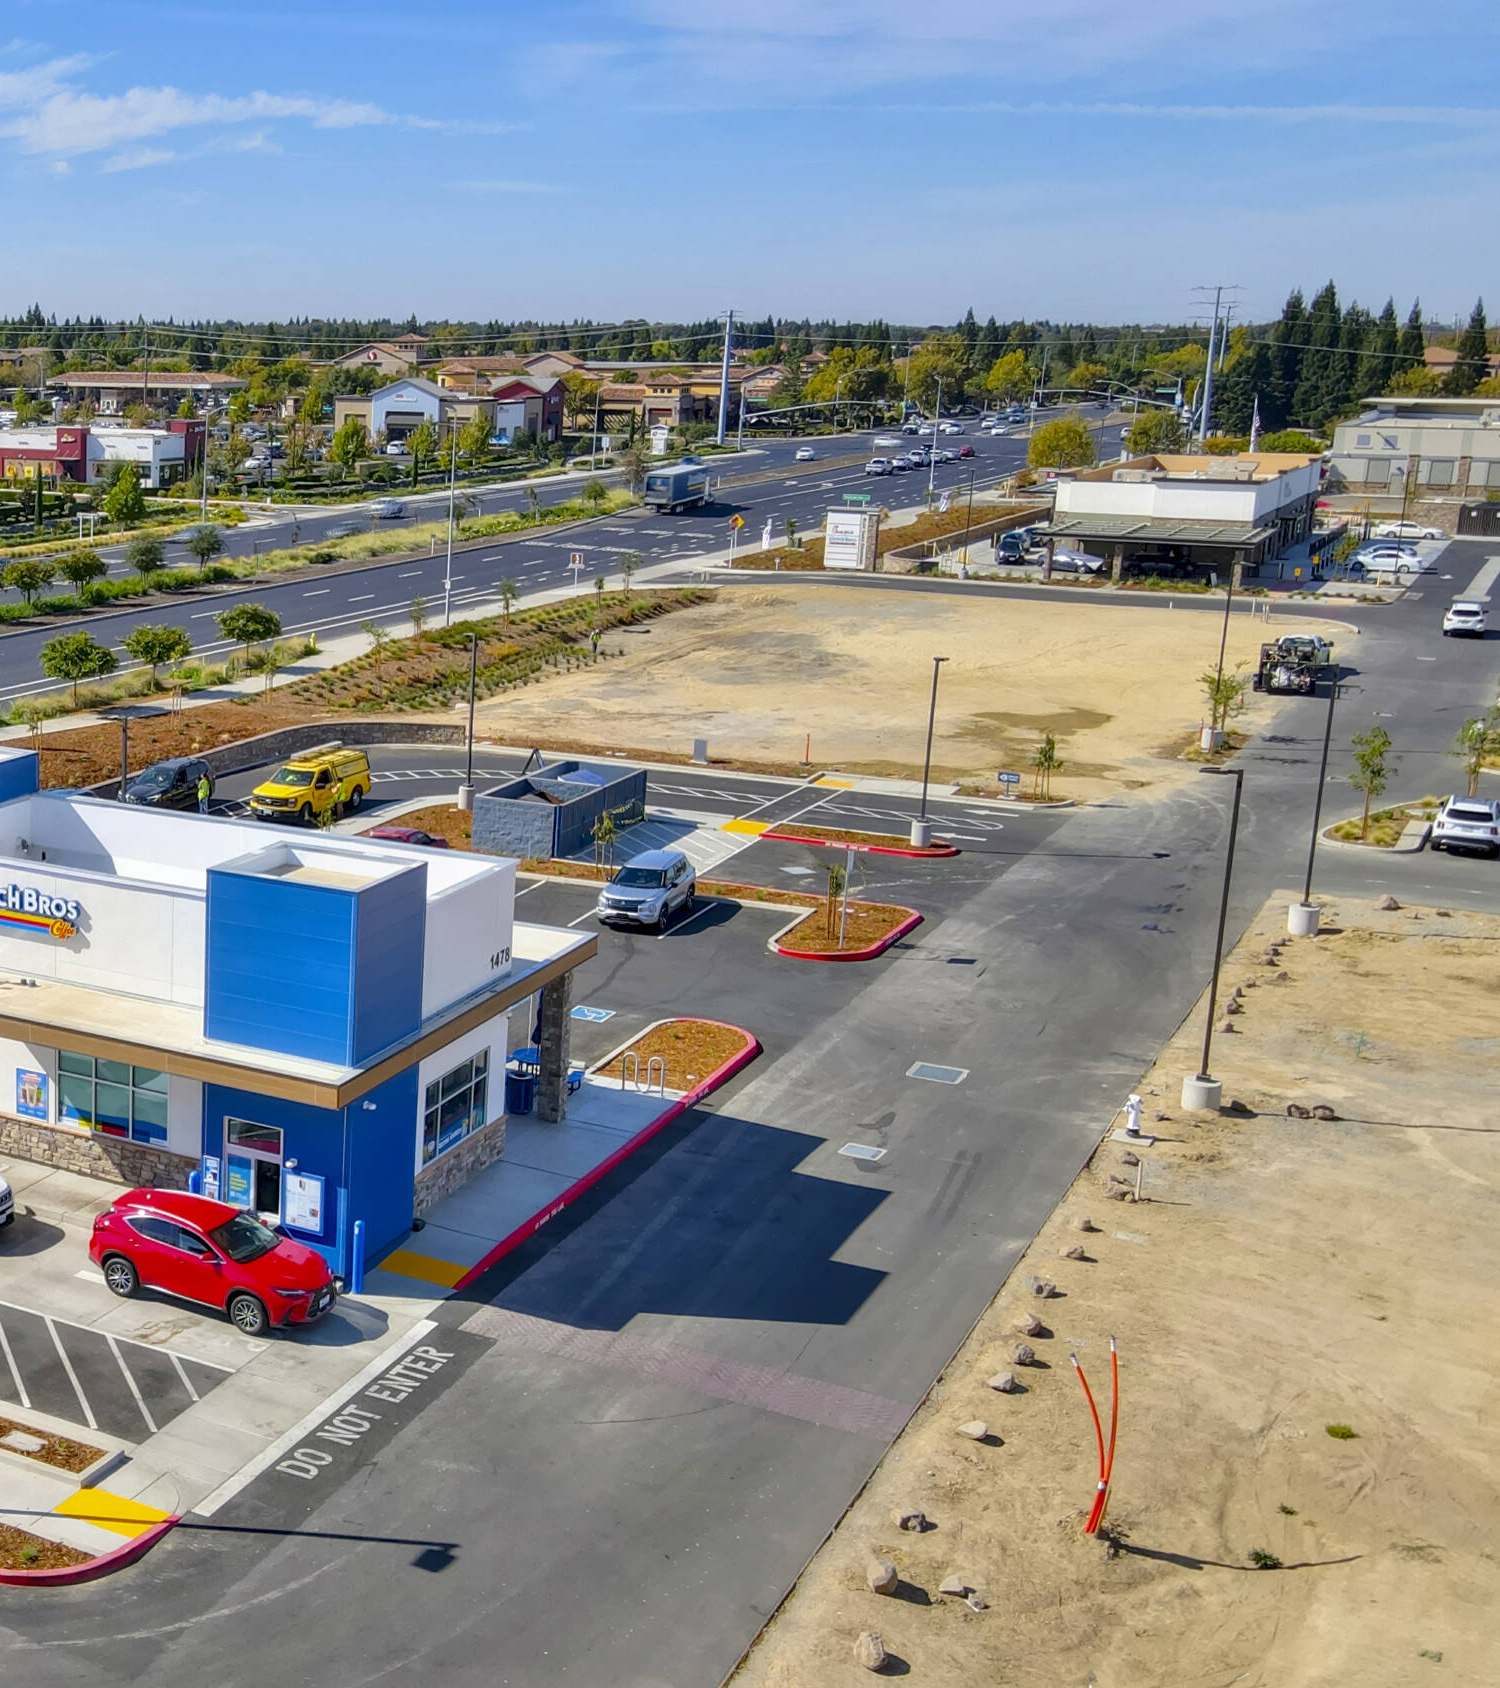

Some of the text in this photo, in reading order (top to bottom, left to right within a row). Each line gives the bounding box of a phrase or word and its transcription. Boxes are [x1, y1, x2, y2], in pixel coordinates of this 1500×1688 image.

[23, 887, 78, 920] BROS
[490, 946, 510, 970] 1478
[275, 1345, 455, 1480] DO NOT ENTER
